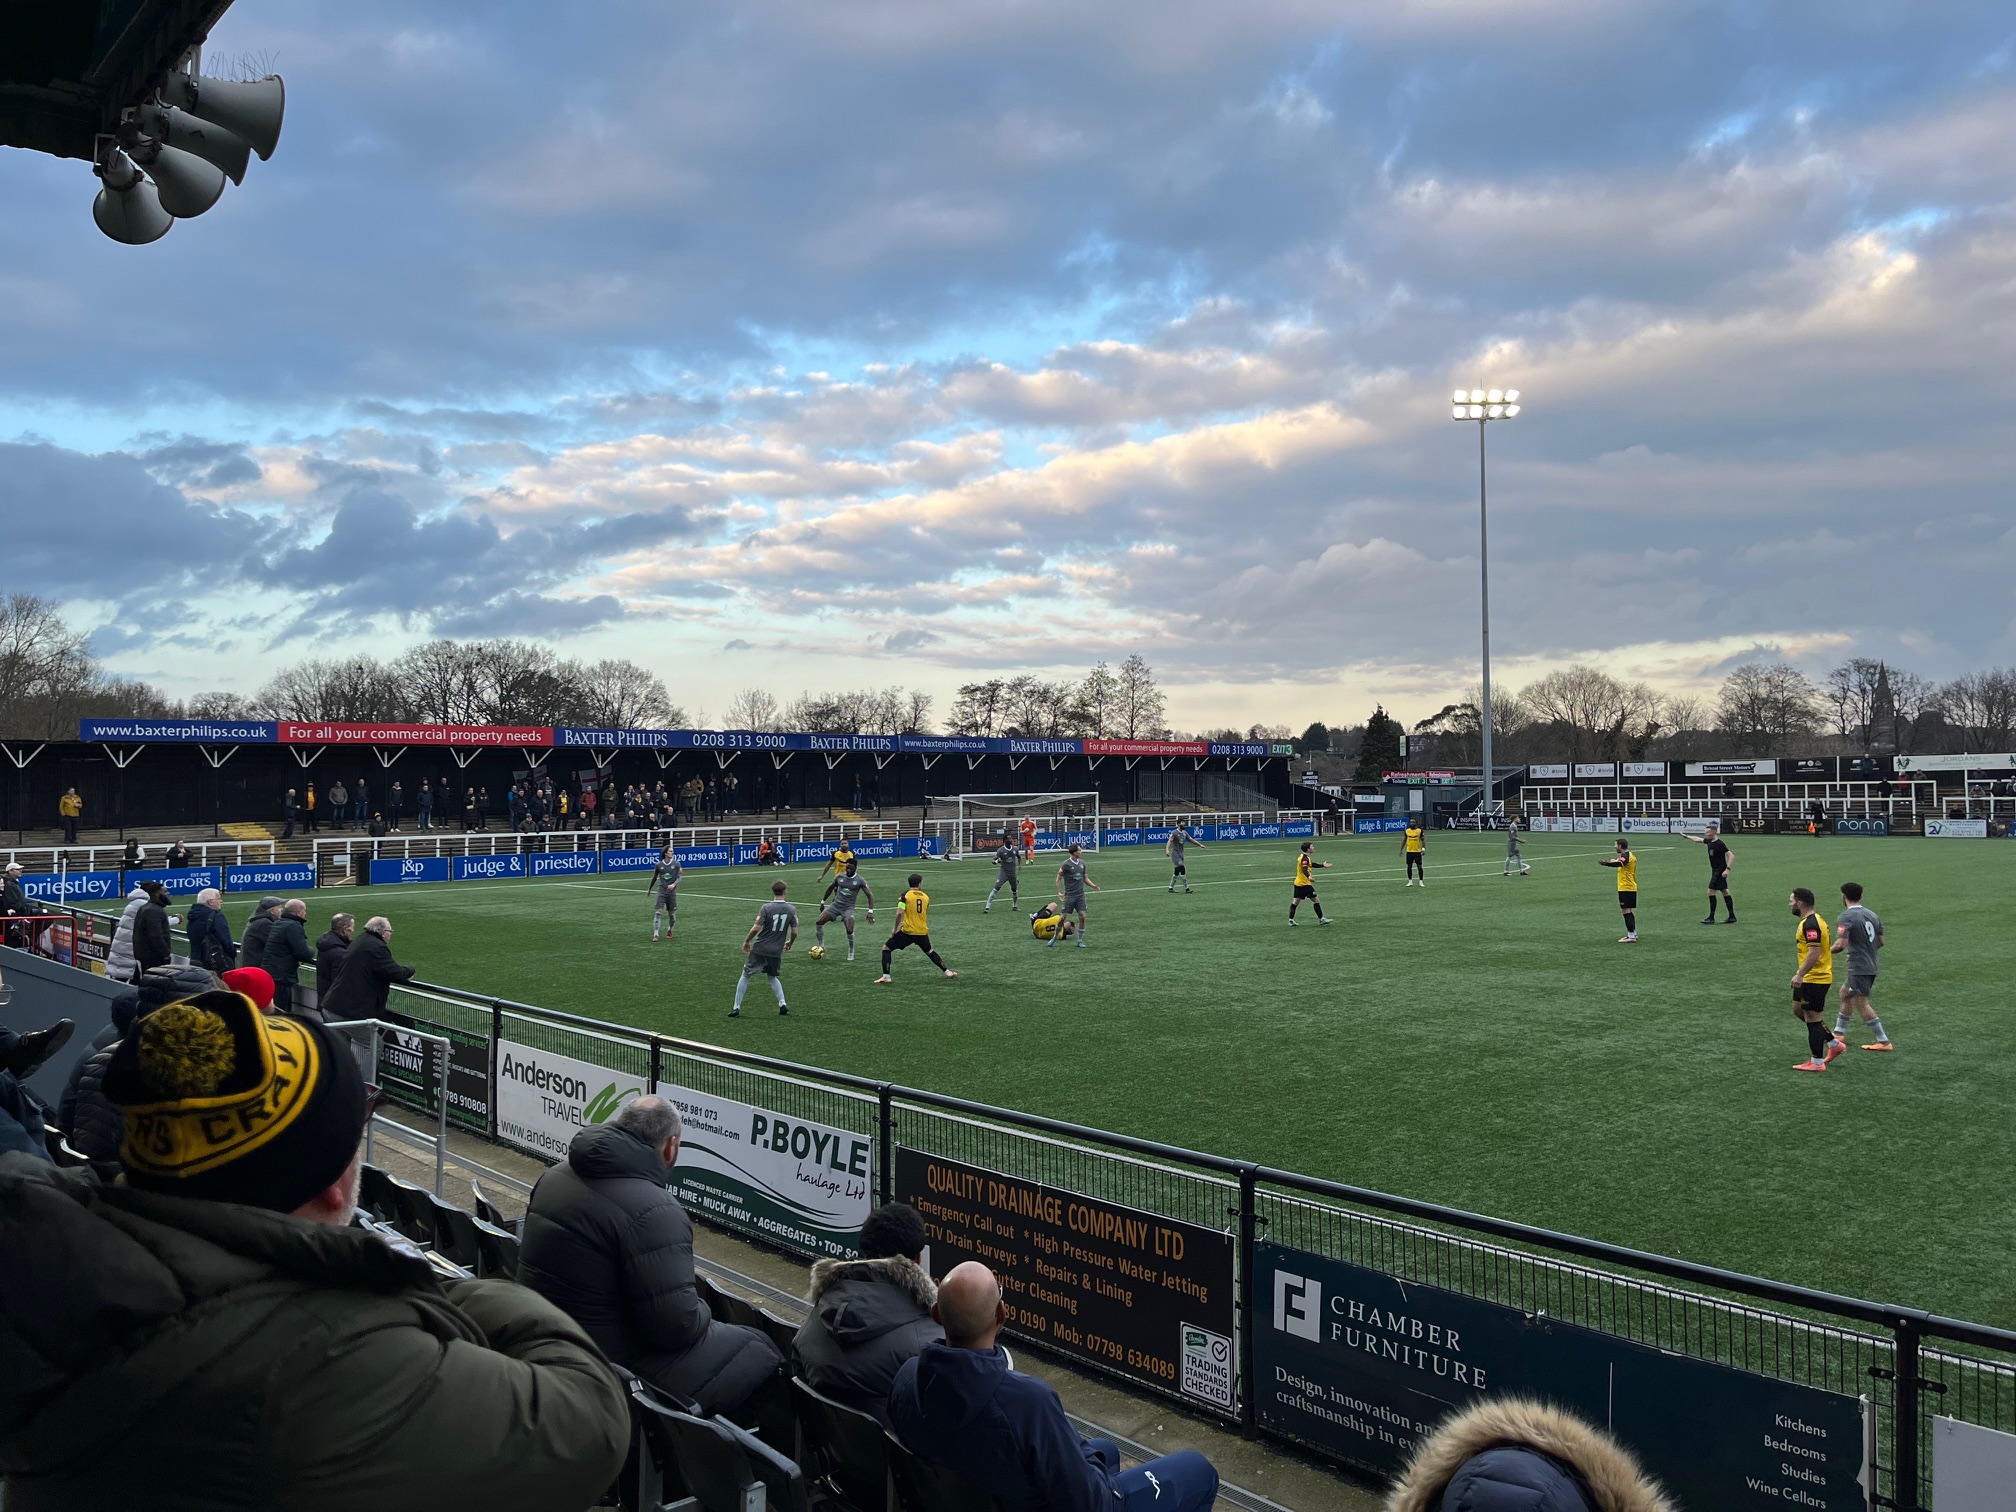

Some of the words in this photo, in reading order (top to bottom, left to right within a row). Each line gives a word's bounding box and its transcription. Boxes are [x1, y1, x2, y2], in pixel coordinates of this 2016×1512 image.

[93, 724, 267, 739] www.baxterphilips.co.uk
[290, 726, 311, 738] For
[316, 727, 332, 739] all
[336, 729, 367, 742] your
[370, 728, 446, 740] commercial
[450, 730, 503, 743] property
[506, 730, 542, 742] needs
[564, 730, 614, 746] BAXTER
[617, 730, 668, 746] PHILIPS
[692, 733, 725, 747] 0208
[729, 734, 752, 747] 313
[756, 735, 786, 747] 9000
[810, 735, 850, 749] BAXTER
[852, 736, 891, 750] PHILIPS
[904, 738, 986, 749] www.baxterphilips.co.uk
[1010, 740, 1041, 752] BAXTER
[1042, 741, 1075, 753] PHILIPS
[1089, 742, 1099, 750] For
[1100, 742, 1108, 751] all
[1108, 743, 1122, 752] your
[1124, 743, 1159, 752] commercial
[1159, 744, 1184, 755] property
[1185, 745, 1203, 753] needs
[1211, 745, 1231, 754] 0208
[1232, 745, 1245, 755] 313
[1246, 745, 1264, 755] 9000
[1193, 827, 1204, 837] j&p
[1219, 828, 1239, 840] judge
[1240, 827, 1246, 836] &
[1252, 825, 1279, 836] priestley
[1358, 820, 1375, 832] judge
[1375, 820, 1381, 829] &
[1385, 819, 1407, 831] priestley
[1743, 820, 1765, 828] LSP
[917, 838, 931, 850] jp
[1067, 833, 1091, 847] judge
[1107, 831, 1139, 845] priestley
[1147, 832, 1171, 840] SOLICITO
[687, 853, 706, 861] 8290
[708, 852, 728, 860] 0333
[776, 845, 785, 858] &
[796, 844, 839, 861] priestle
[853, 846, 893, 855] SOLICITORS
[400, 859, 424, 876] j&p
[462, 859, 505, 877] judge
[509, 856, 522, 871] &
[534, 855, 594, 873] priestley
[608, 856, 660, 867] SOLICITORS
[24, 876, 112, 897] priestley
[133, 876, 211, 890] SICITORS
[230, 874, 251, 884] 020
[254, 873, 282, 883] 8290
[284, 871, 312, 881] 0333
[916, 899, 923, 914] 8
[772, 913, 788, 932] 11
[1865, 920, 1876, 943] 9
[501, 1052, 588, 1102] Anderson
[437, 1087, 458, 1104] 0789
[459, 1095, 487, 1115] 910808
[669, 1099, 689, 1114] 7958
[690, 1104, 703, 1116] 981
[704, 1108, 718, 1121] 073
[541, 1095, 586, 1128] TRAVEL
[501, 1118, 573, 1157] www.anderso
[680, 1115, 740, 1141] leh@hotmail.com
[750, 1113, 870, 1178] P.BOYLE
[682, 1178, 706, 1192] LICENCED
[705, 1184, 721, 1196] WASTE
[721, 1189, 744, 1204] CARRIER
[796, 1163, 842, 1199] haulage
[845, 1179, 866, 1200] Ltd
[665, 1183, 679, 1196] RAB
[679, 1187, 697, 1203] HIRE
[702, 1196, 727, 1214] MUCK
[727, 1204, 752, 1223] AWAY
[757, 1216, 817, 1247] AGGREGATES
[824, 1238, 844, 1256] TOP
[844, 1246, 859, 1260] SO
[926, 1163, 984, 1203] QUALITY
[988, 1181, 1063, 1228] DRAINAGE
[1067, 1202, 1149, 1251] COMPANY
[1154, 1226, 1185, 1262] LTD
[917, 1196, 971, 1229] Emergency
[973, 1215, 993, 1236] Call
[995, 1222, 1015, 1240] out
[1033, 1232, 1060, 1256] High
[1062, 1241, 1115, 1271] Pressure
[1118, 1258, 1158, 1284] Water
[1161, 1271, 1209, 1304] Jetting
[922, 1221, 943, 1241] CTV
[946, 1228, 973, 1249] Drain
[975, 1238, 1018, 1266] Surveys
[1035, 1258, 1079, 1287] Repairs
[1082, 1273, 1092, 1290] &
[1096, 1277, 1134, 1308] Lining
[1028, 1283, 1079, 1316] Cleaning
[1330, 1295, 1462, 1352] CHAMBER
[1019, 1308, 1047, 1333] 0190
[1053, 1321, 1083, 1347] Mob:
[1086, 1333, 1124, 1362] 07798
[1127, 1348, 1176, 1381] 634089
[1330, 1321, 1487, 1390] FURNITURE
[1185, 1353, 1228, 1379] TRADING
[1185, 1366, 1228, 1389] STANDARDS
[1185, 1377, 1228, 1401] CHECKED
[1275, 1366, 1327, 1400] Design,
[1330, 1386, 1412, 1430] innovation
[1414, 1419, 1434, 1437] an
[1276, 1390, 1375, 1440] craftsmanship
[1378, 1425, 1394, 1445] in
[1775, 1413, 1827, 1438] Kitchens
[1763, 1434, 1827, 1462] Bedrooms
[1781, 1462, 1827, 1486] Studies
[1746, 1476, 1779, 1498] Wine
[1782, 1486, 1827, 1510] Cellars
